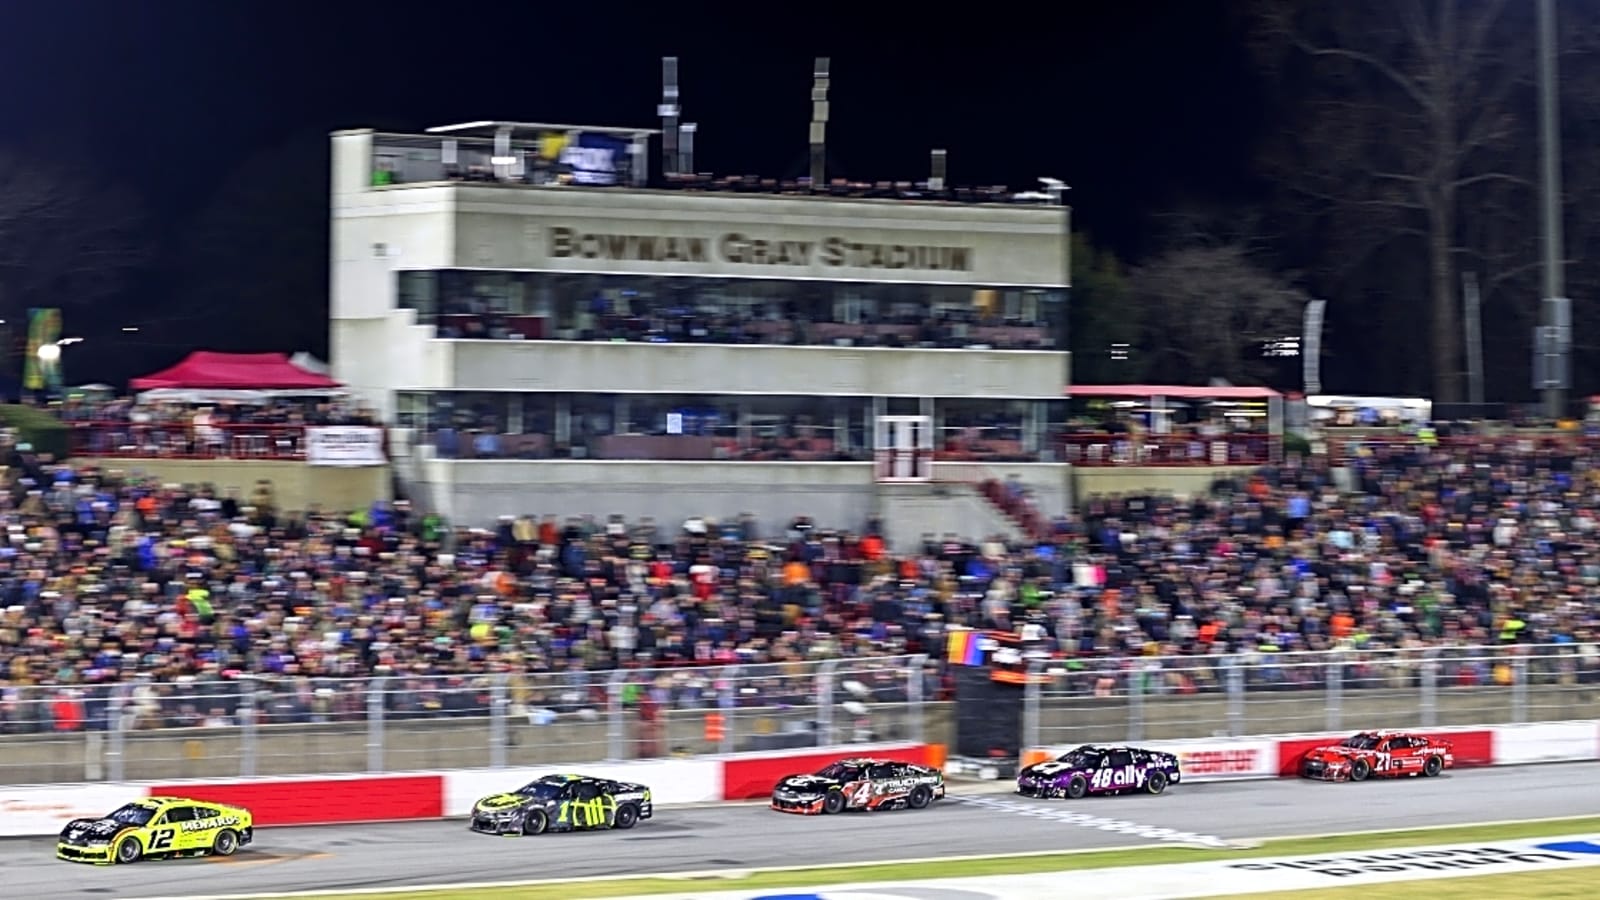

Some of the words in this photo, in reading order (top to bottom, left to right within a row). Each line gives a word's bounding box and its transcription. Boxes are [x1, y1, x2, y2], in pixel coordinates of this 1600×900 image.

[550, 226, 708, 261] BOWMAN
[721, 233, 811, 265] GRAY
[820, 237, 973, 271] STADIUM
[1374, 751, 1391, 771] 21
[1091, 768, 1113, 788] 48
[1114, 765, 1146, 787] ally
[854, 782, 871, 804] 4
[558, 800, 570, 823] 1
[148, 829, 175, 849] 12
